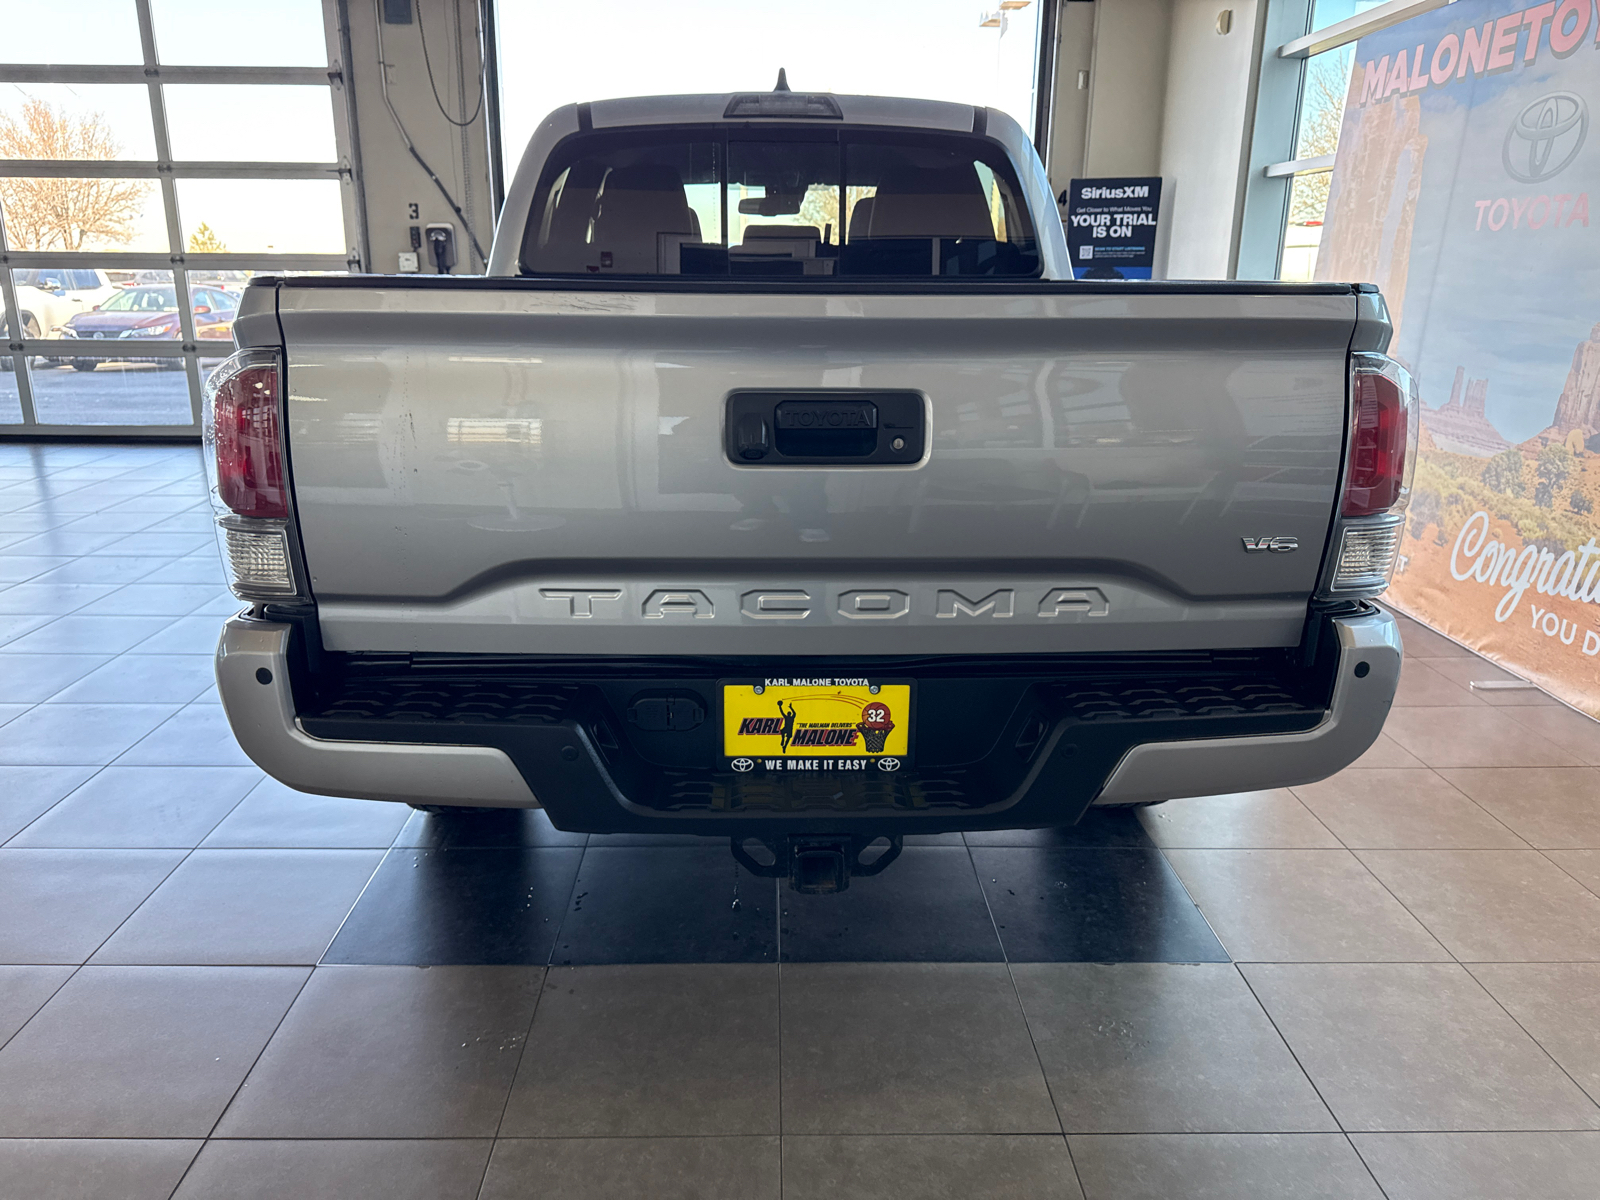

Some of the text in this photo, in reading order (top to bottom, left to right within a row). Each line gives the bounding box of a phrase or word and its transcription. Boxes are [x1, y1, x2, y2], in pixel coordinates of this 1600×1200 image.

[1359, 0, 1600, 106] MALONETO
[1081, 186, 1149, 199] SiriusXM
[409, 203, 419, 219] 3
[1475, 193, 1589, 231] TOYOTA
[1071, 213, 1157, 227] YOUR TRIAL
[1093, 226, 1133, 238] IS ON
[786, 410, 871, 427] TOYOTA
[1241, 536, 1298, 553] V6
[538, 587, 1111, 619] TACOMA
[1531, 604, 1577, 645] YOU
[867, 709, 885, 722] 32
[738, 718, 784, 735] KARL
[791, 729, 859, 746] MALONE
[765, 759, 867, 770] WE MAKE IT EASY
